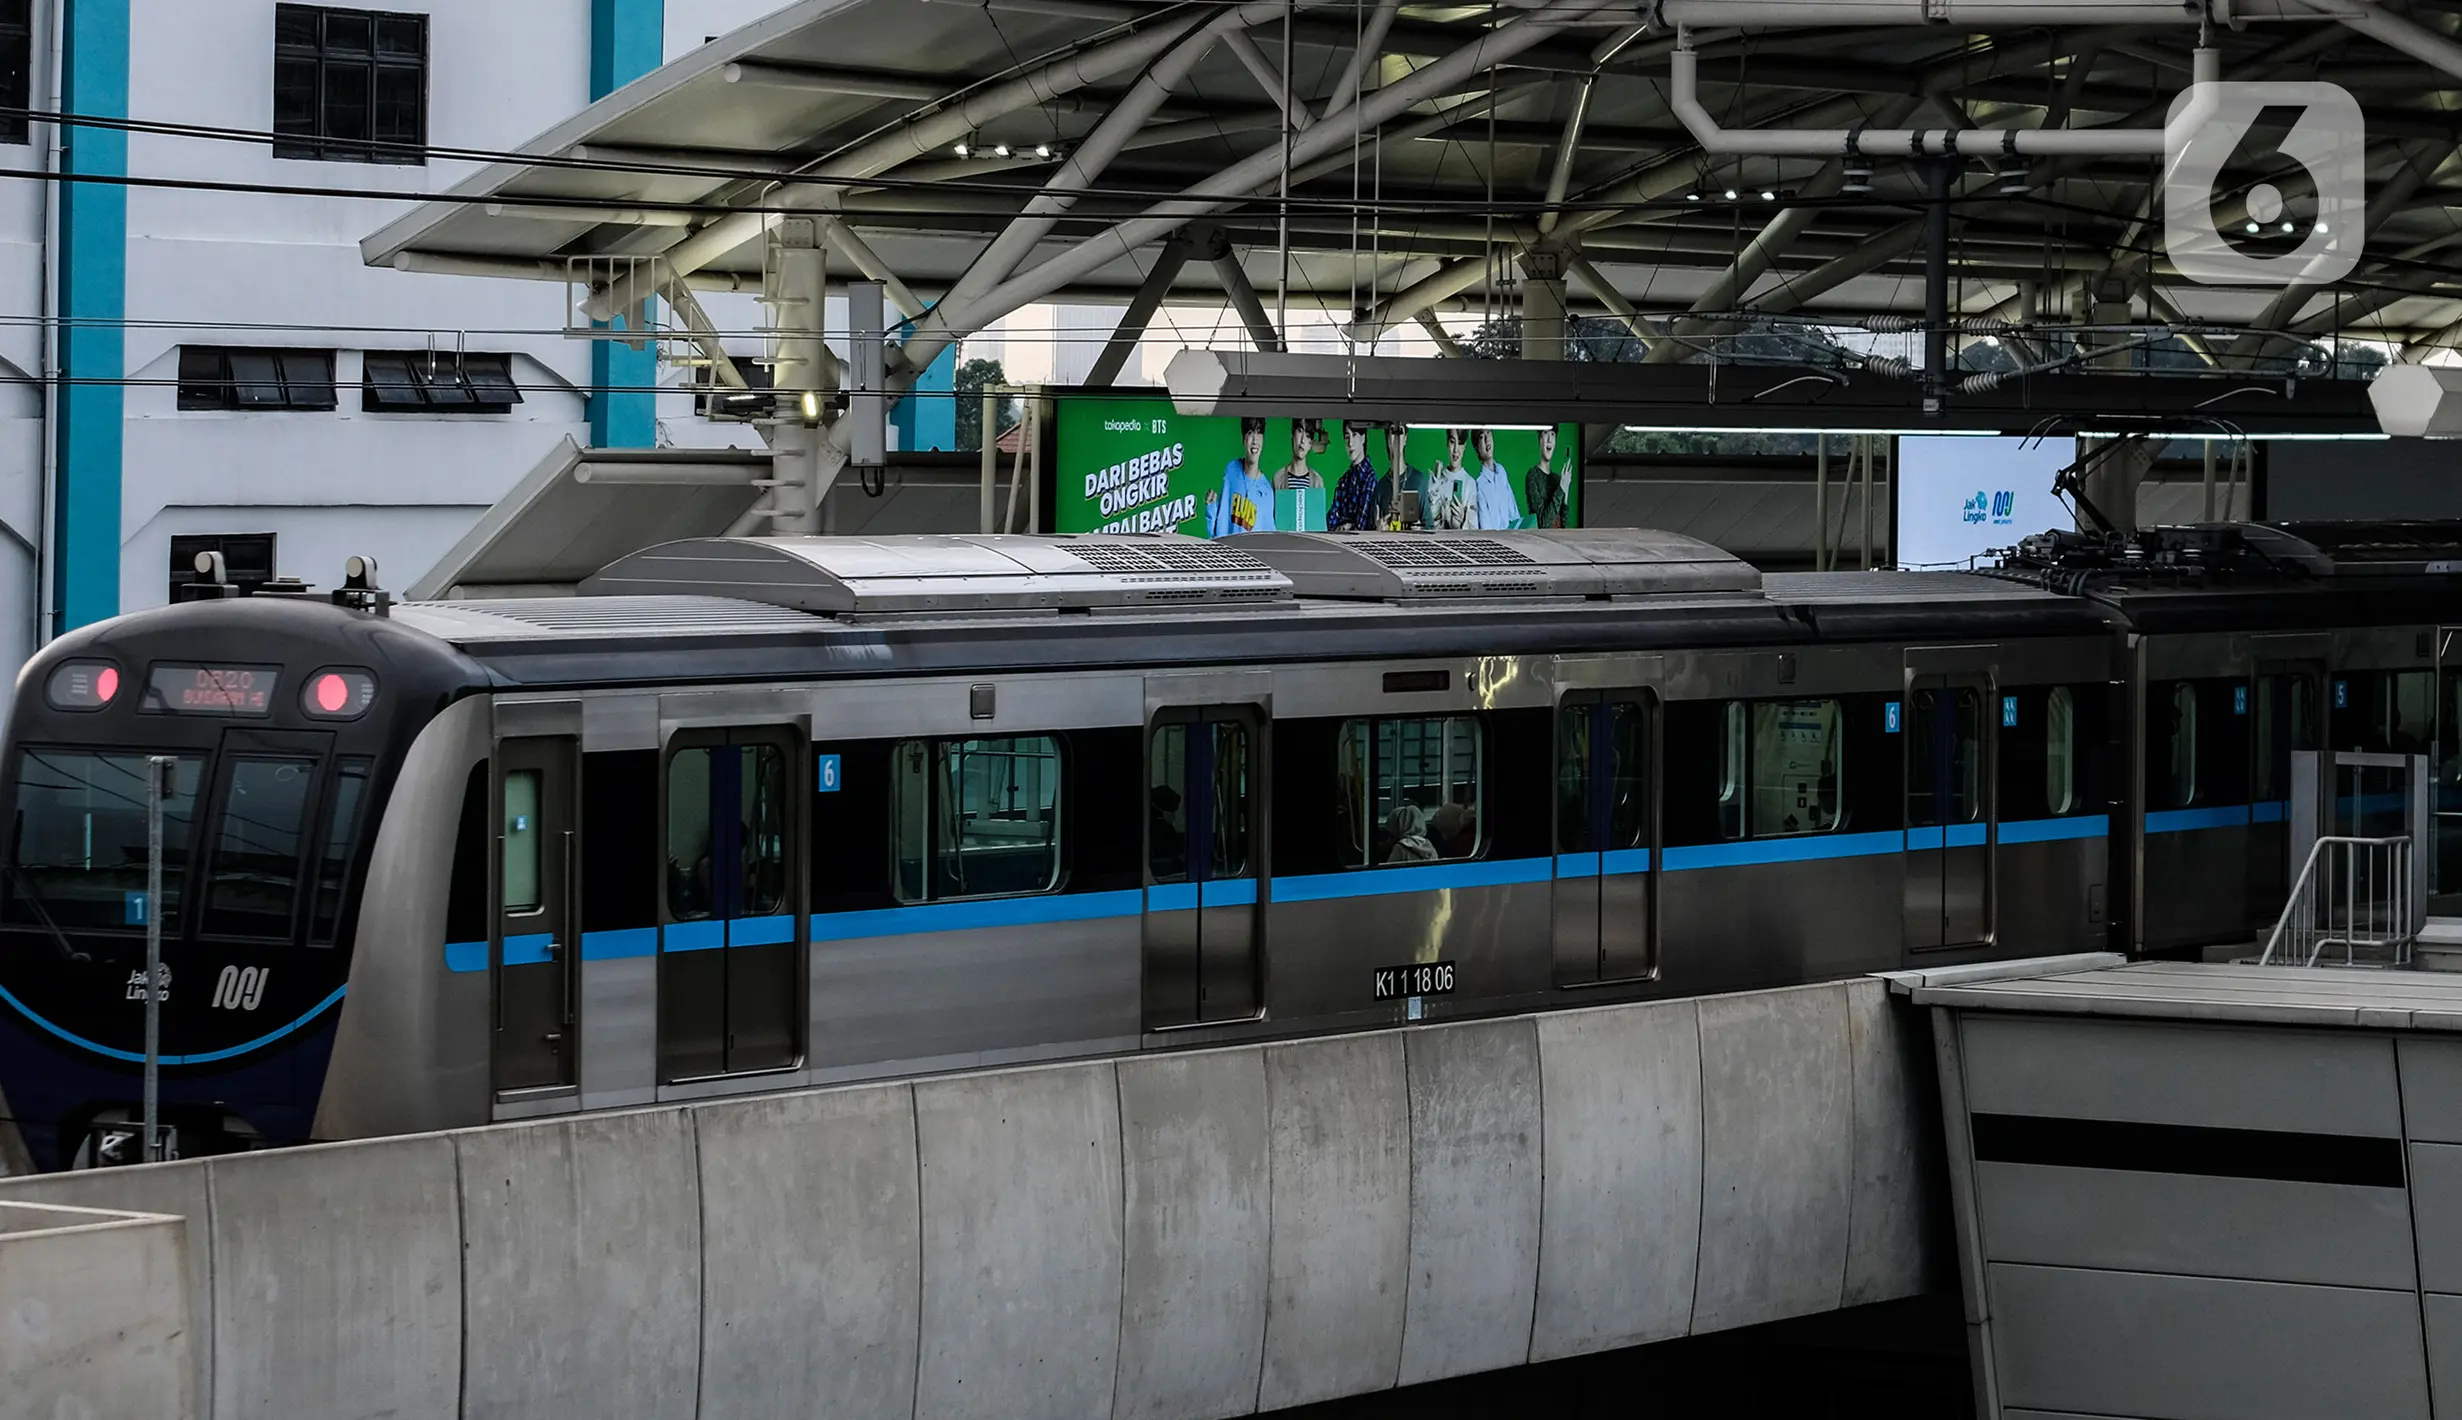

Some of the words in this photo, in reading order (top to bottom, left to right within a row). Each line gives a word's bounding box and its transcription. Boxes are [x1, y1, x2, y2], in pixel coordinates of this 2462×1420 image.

[1104, 419, 1141, 433] tokopedia
[1152, 420, 1167, 434] BTS
[1085, 461, 1126, 498] DARI
[1128, 442, 1183, 482] BEBAS
[1100, 472, 1168, 517] ONGKIR
[1139, 494, 1196, 533] BAYAR
[1964, 511, 1987, 525] Lingko
[2338, 684, 2344, 704] 5
[1889, 706, 1896, 729] 6
[824, 760, 834, 787] 6
[1376, 971, 1394, 996] K1
[1401, 970, 1407, 994] 1
[1414, 968, 1431, 992] 18
[1435, 965, 1453, 990] 06
[126, 985, 170, 1004] Lino
